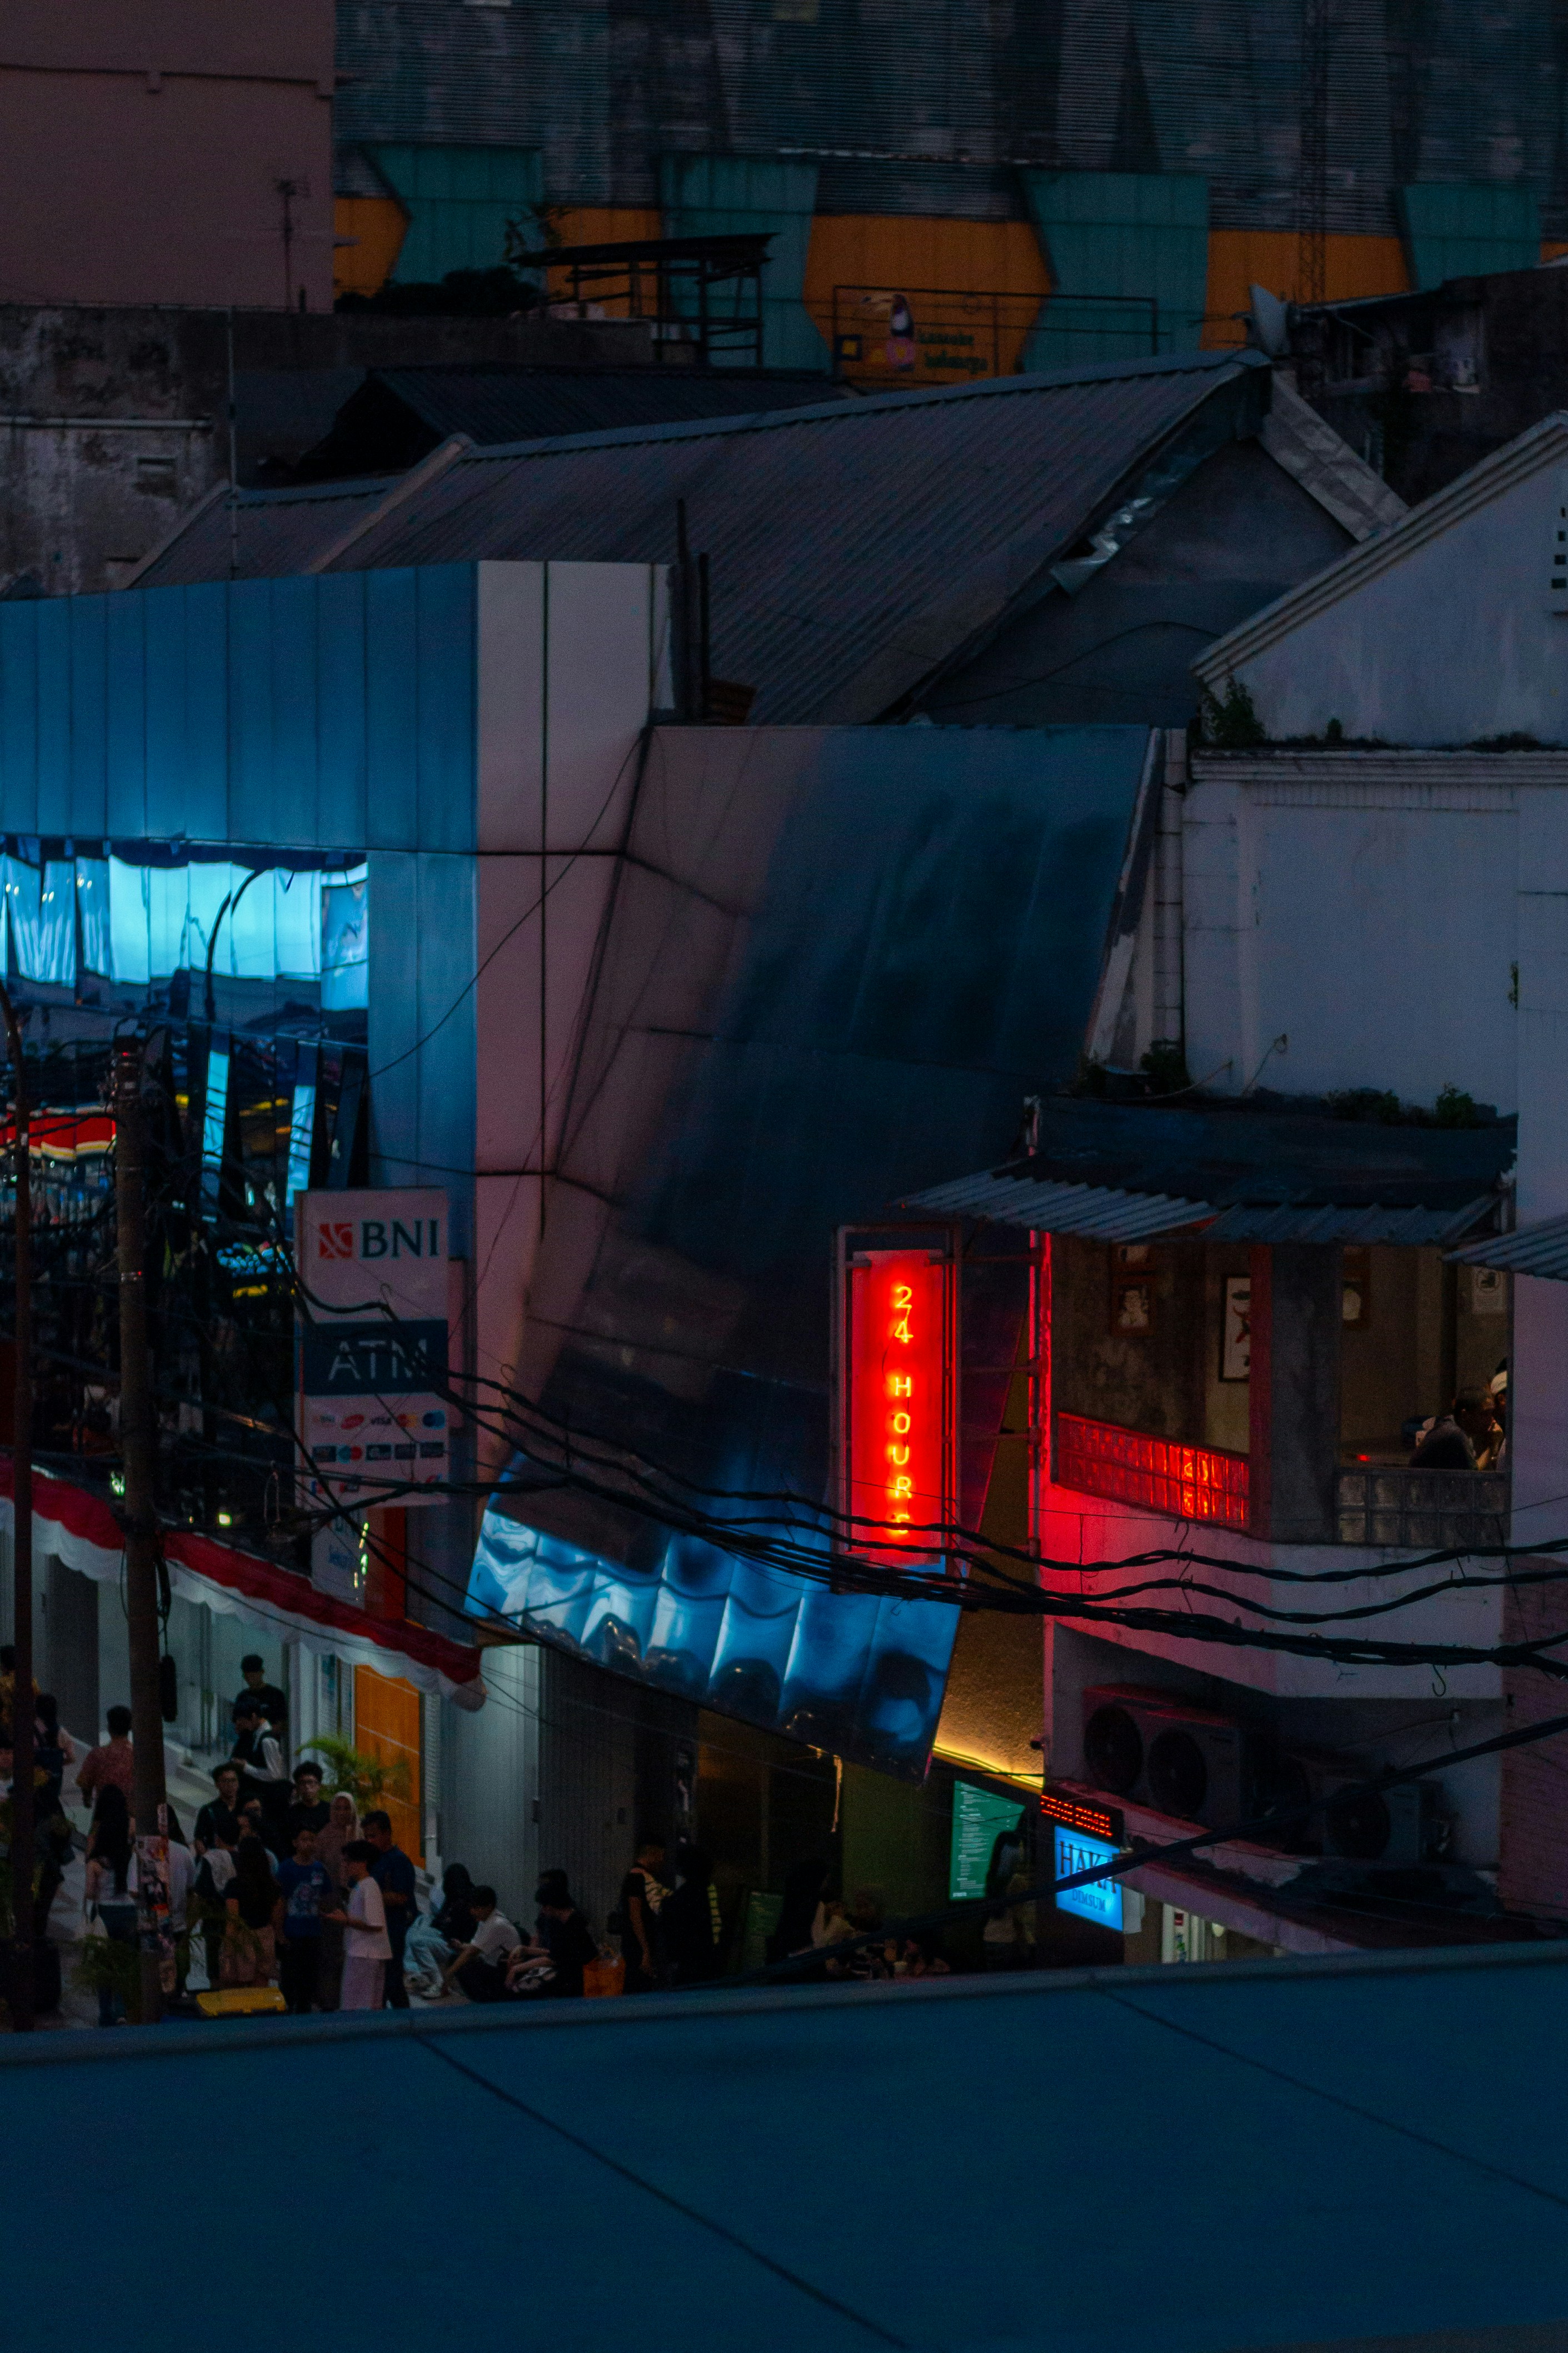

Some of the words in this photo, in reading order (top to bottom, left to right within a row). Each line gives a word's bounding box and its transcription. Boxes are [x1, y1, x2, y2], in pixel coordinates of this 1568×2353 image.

[361, 1219, 438, 1258] BNI
[895, 1286, 913, 1343] 24
[328, 1338, 427, 1380] ATM
[893, 1377, 912, 1534] HOURS
[1072, 1889, 1106, 1912] DIMSUM
